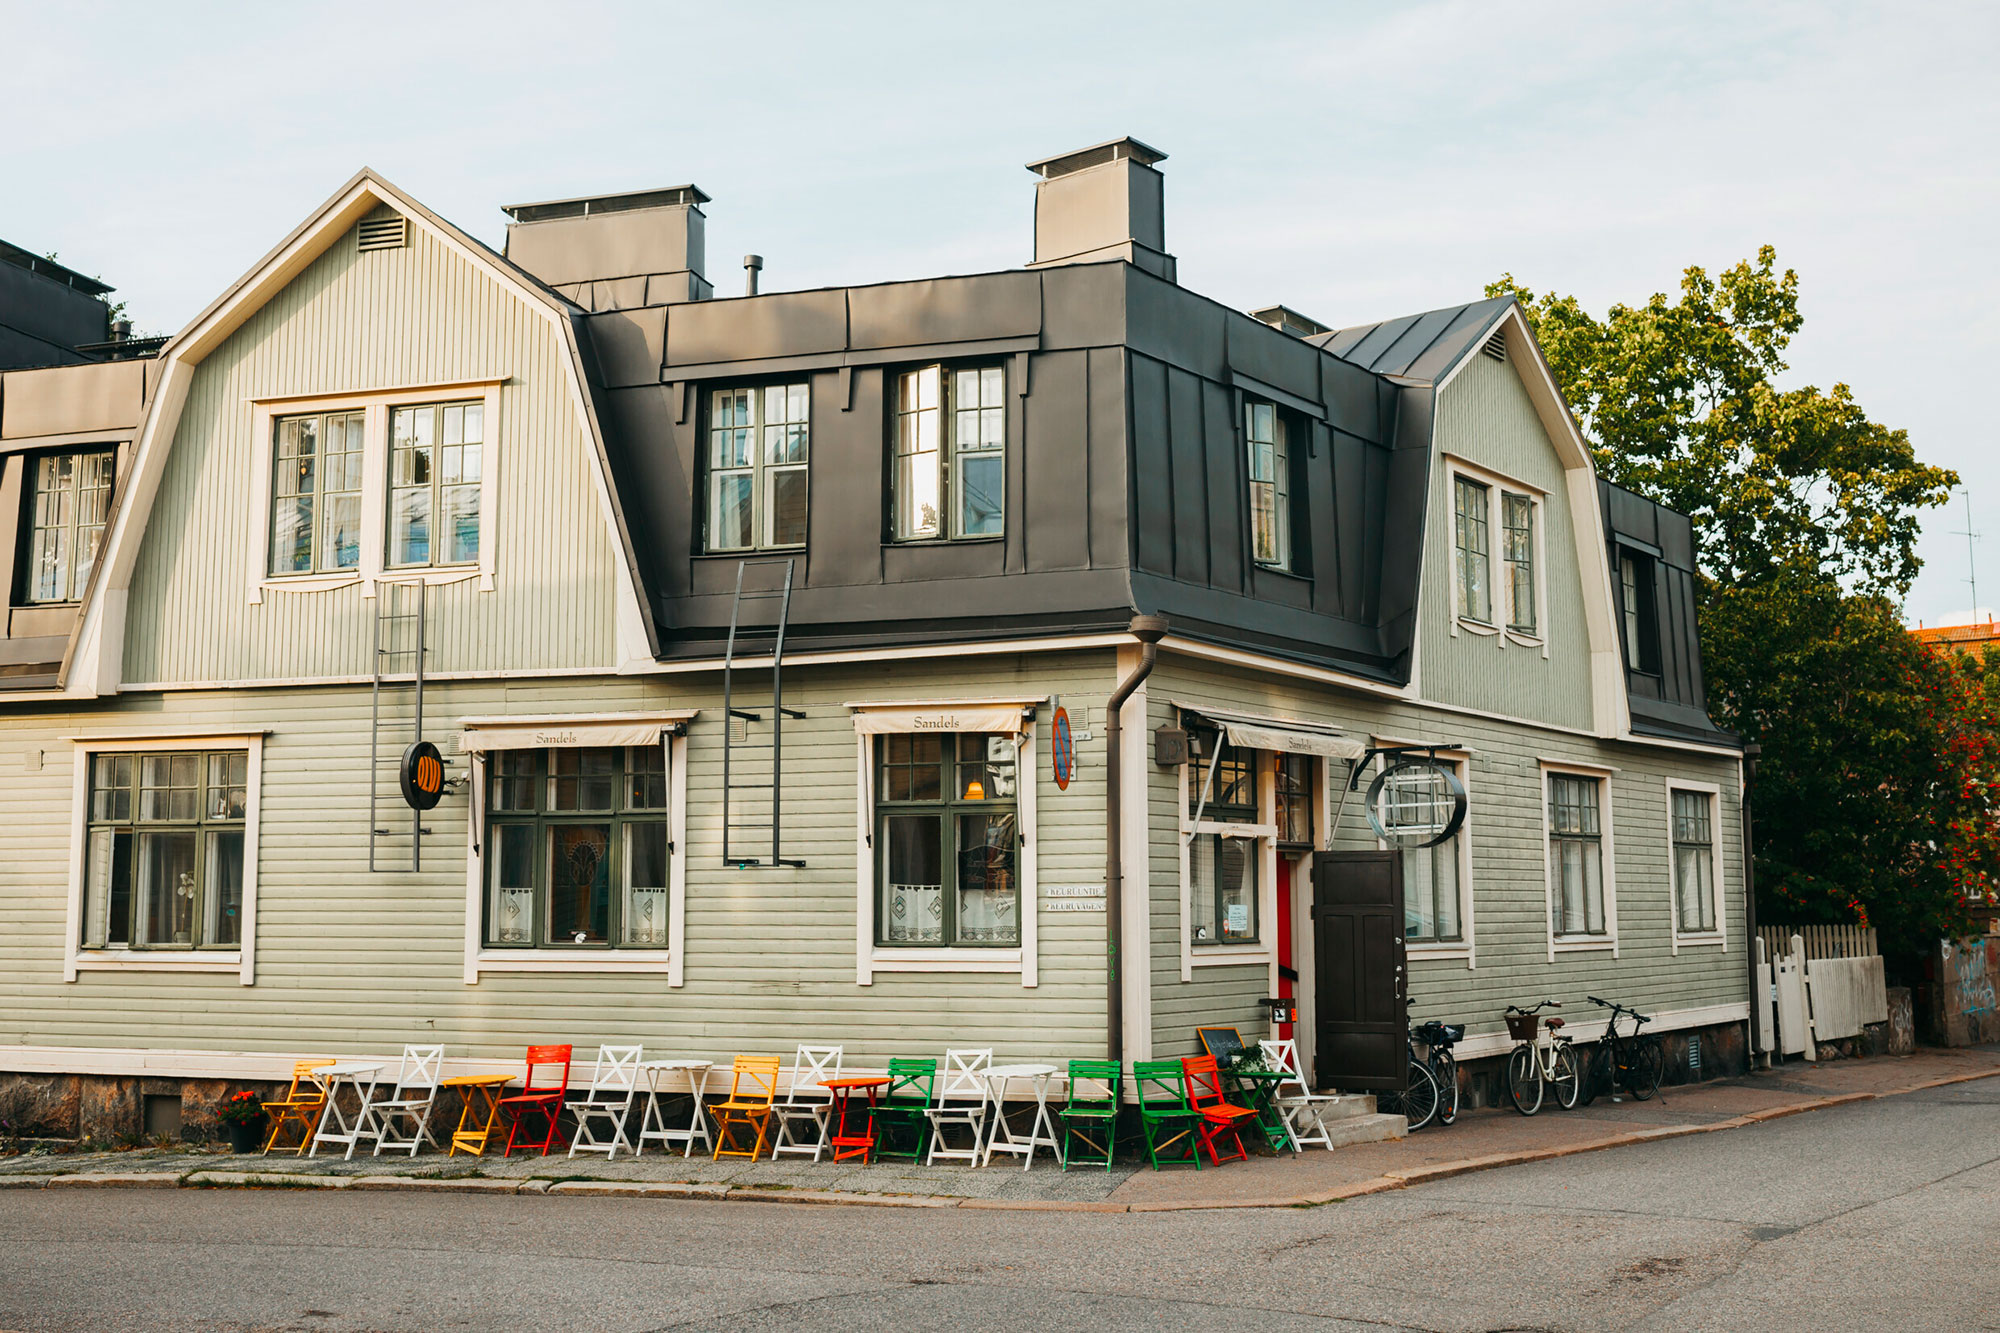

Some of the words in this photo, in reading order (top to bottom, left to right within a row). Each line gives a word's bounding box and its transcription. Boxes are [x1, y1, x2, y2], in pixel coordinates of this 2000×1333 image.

[914, 715, 960, 729] Sandels
[536, 731, 577, 744] Sandels
[417, 756, 441, 793] OLVI
